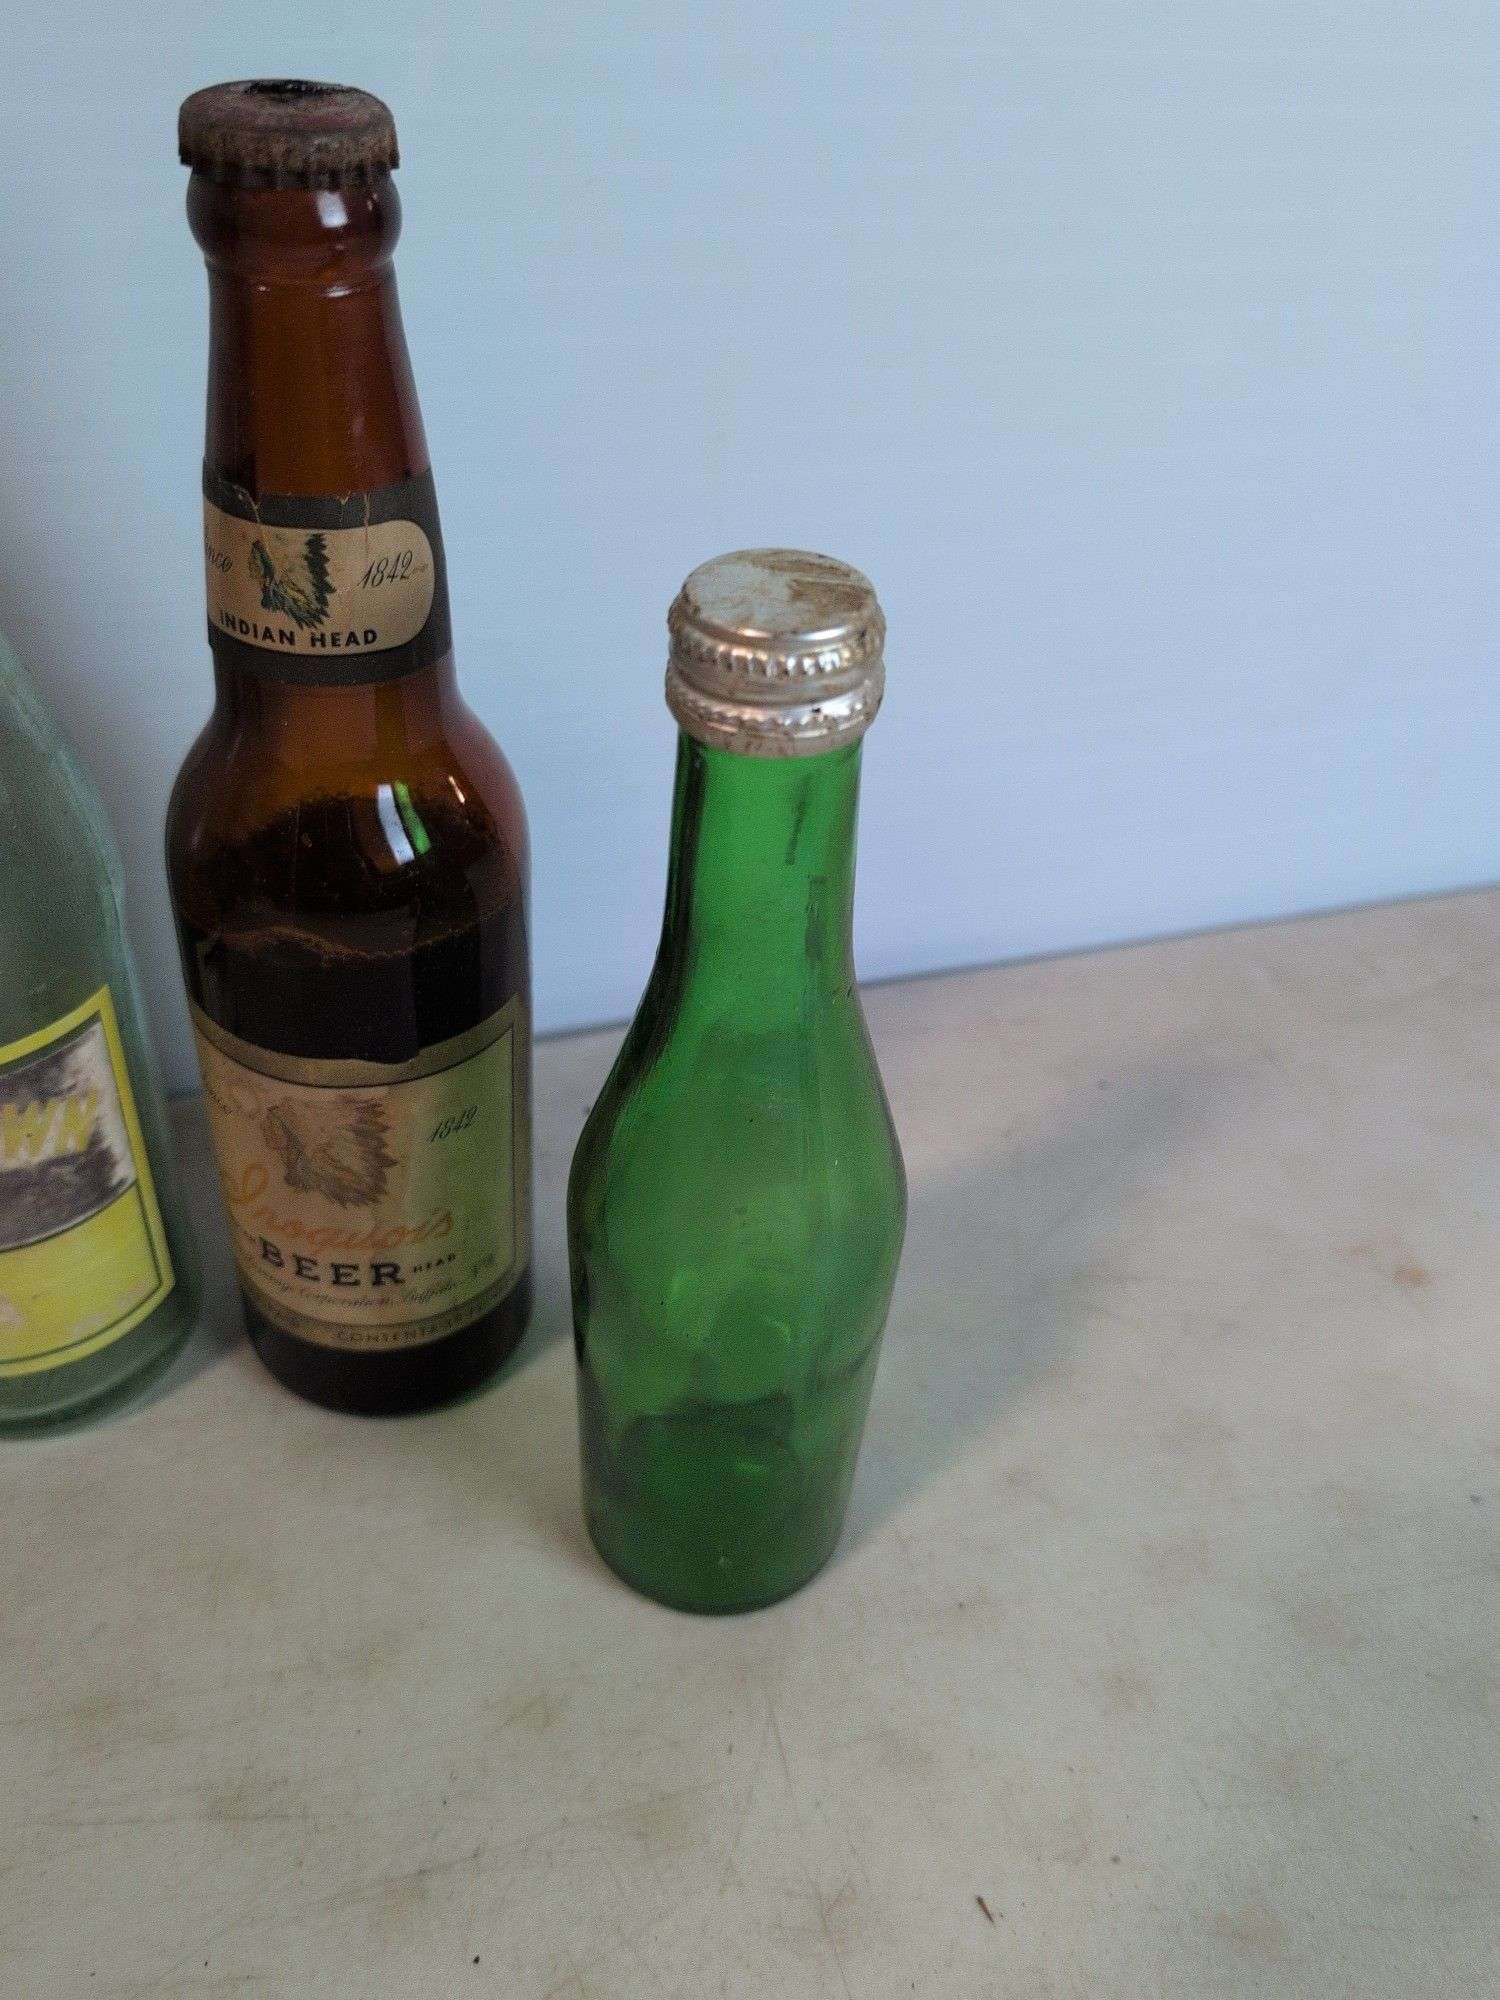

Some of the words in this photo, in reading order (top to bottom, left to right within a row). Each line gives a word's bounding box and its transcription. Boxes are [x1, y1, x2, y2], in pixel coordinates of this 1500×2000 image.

[357, 550, 413, 589] 1842
[218, 610, 297, 646] INDIAN
[310, 628, 379, 648] HEAD
[430, 1105, 478, 1143] 1842
[258, 1236, 405, 1287] BEER
[412, 1253, 457, 1274] HEAD
